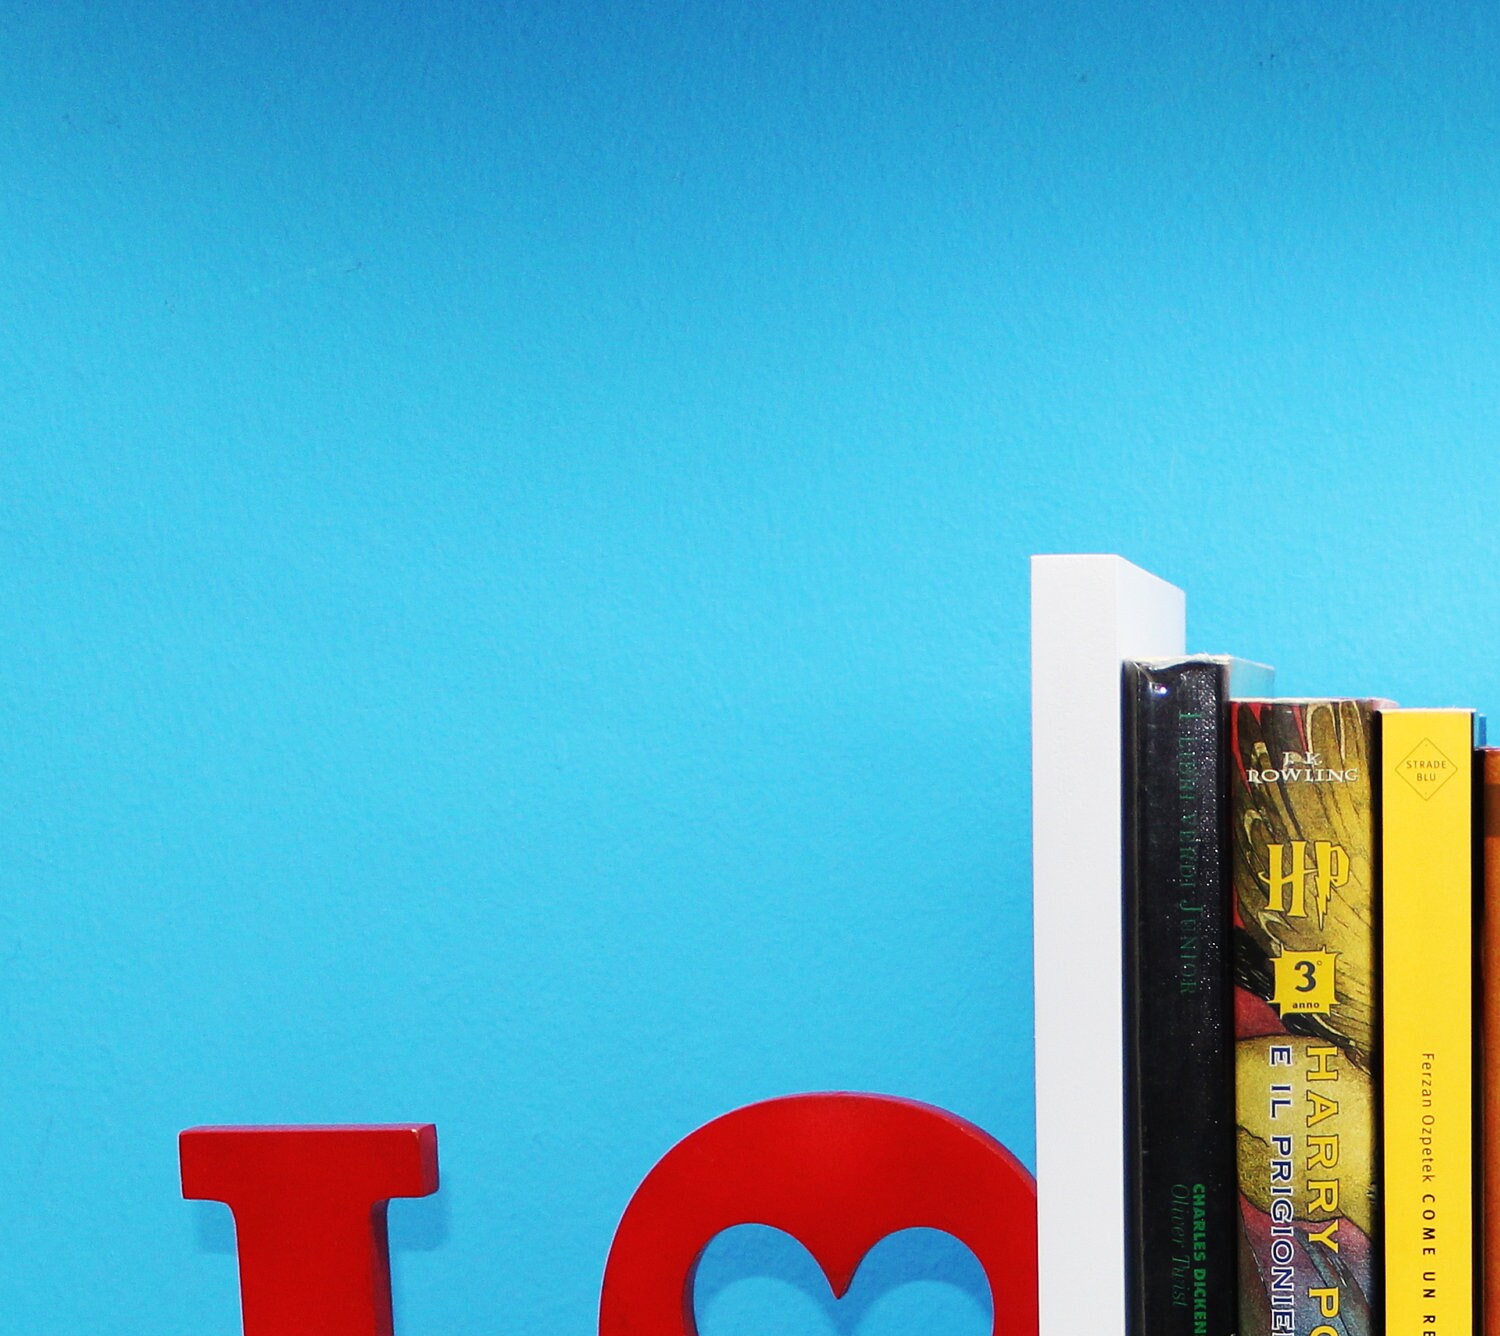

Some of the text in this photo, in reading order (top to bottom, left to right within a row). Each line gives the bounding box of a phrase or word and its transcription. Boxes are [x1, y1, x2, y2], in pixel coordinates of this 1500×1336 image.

[1246, 768, 1359, 784] ROWLING
[1406, 760, 1447, 770] STRADE
[1416, 773, 1437, 782] BLU
[1258, 840, 1350, 931] HP
[1269, 1046, 1292, 1066] E
[1421, 1053, 1435, 1108] Ferzan
[1270, 1083, 1292, 1119] IL
[1306, 1045, 1340, 1254] HARRY
[1418, 1114, 1437, 1183] Ozpetek
[1170, 1184, 1190, 1307] Oliver Twist
[1191, 1183, 1206, 1262] CHARLES
[1421, 1193, 1437, 1256] COME
[1422, 1270, 1437, 1299] UN
